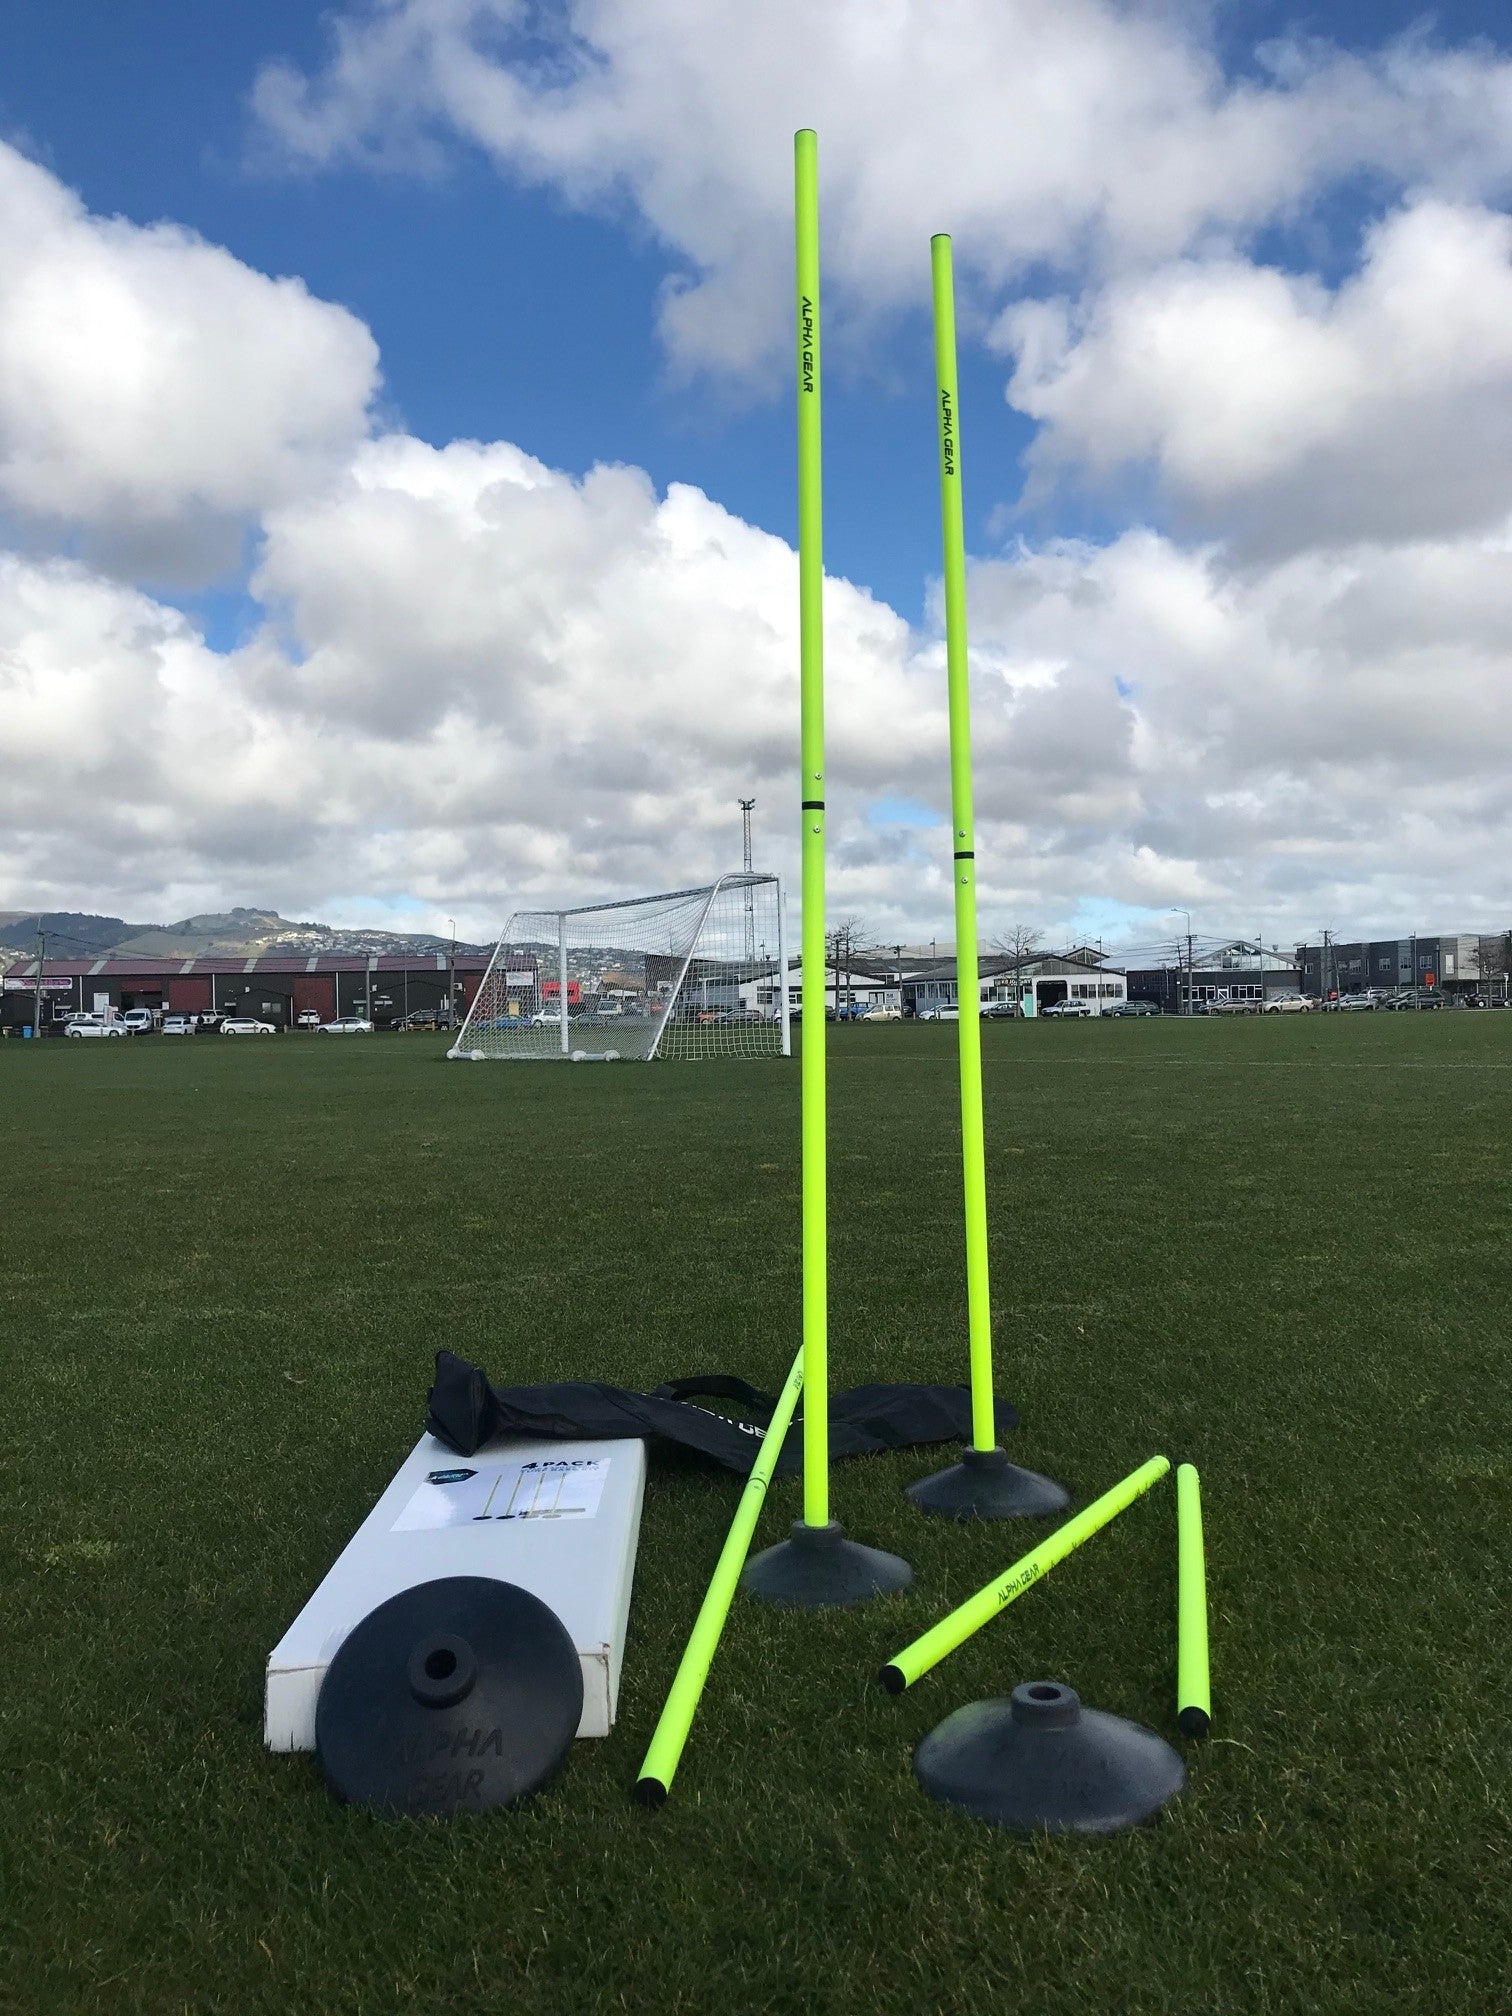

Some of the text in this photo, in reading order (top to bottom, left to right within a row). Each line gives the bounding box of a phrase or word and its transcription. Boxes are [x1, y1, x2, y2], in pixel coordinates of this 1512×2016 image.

[802, 296, 814, 392] ALPHA GEAR
[941, 389, 955, 475] ALPHA GEAR
[998, 1563, 1040, 1605] ALPHA GEAR
